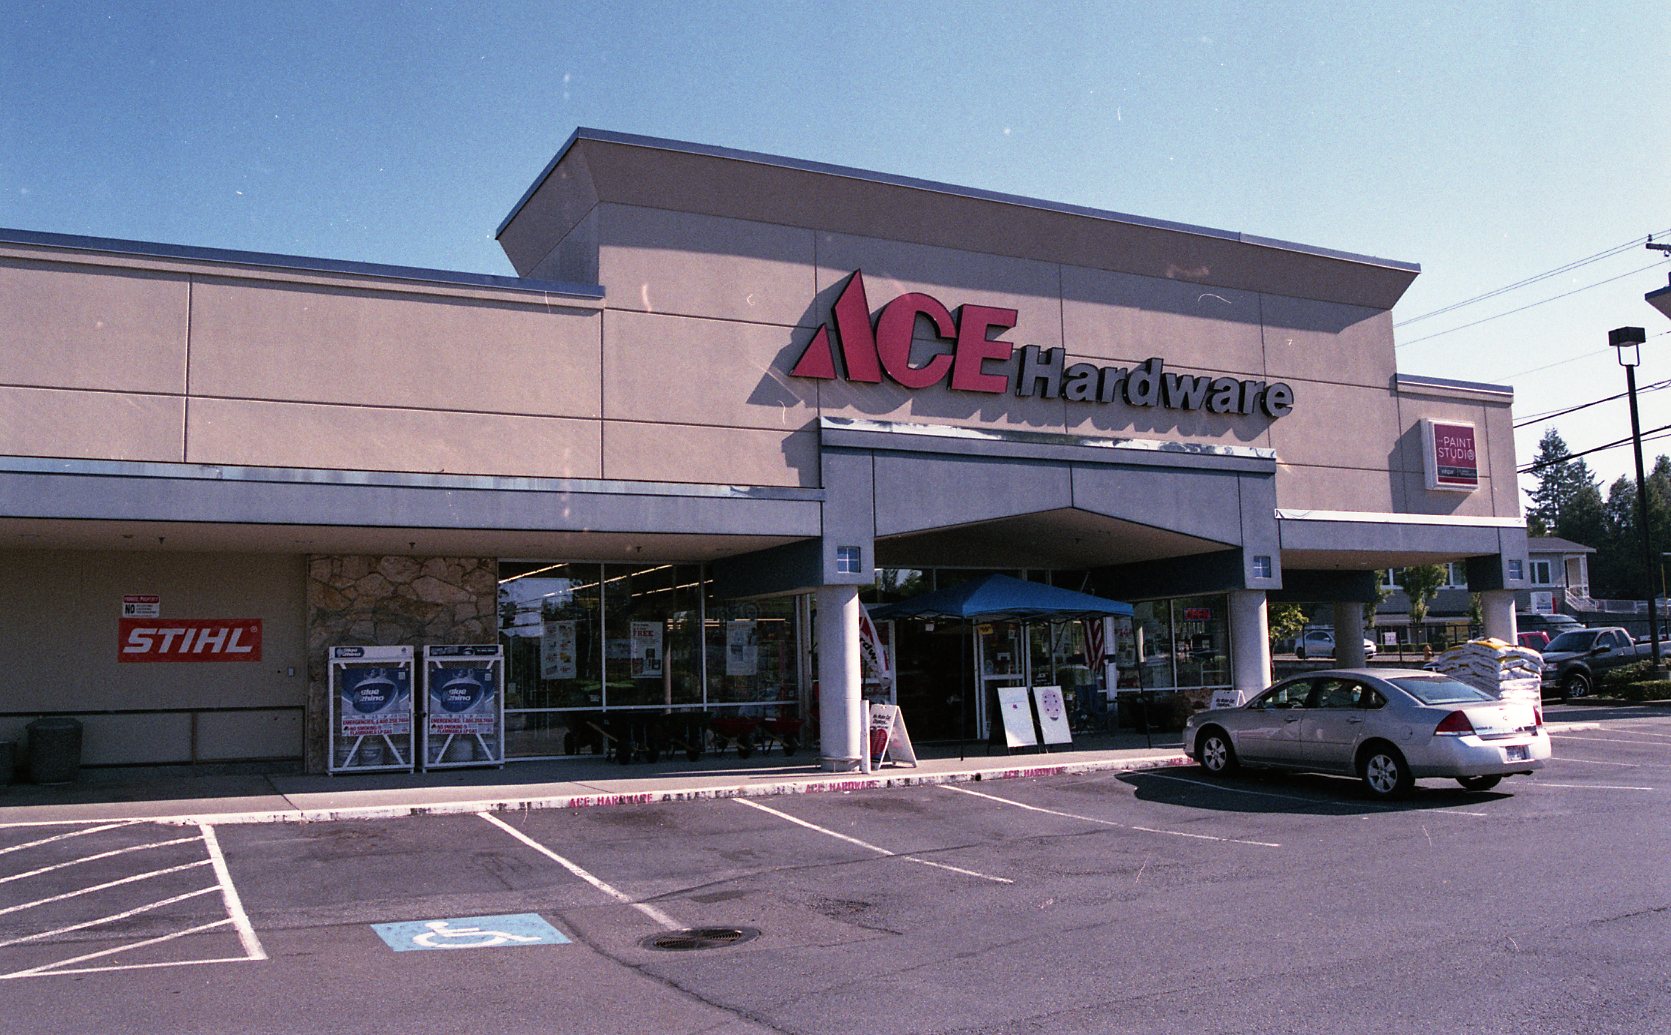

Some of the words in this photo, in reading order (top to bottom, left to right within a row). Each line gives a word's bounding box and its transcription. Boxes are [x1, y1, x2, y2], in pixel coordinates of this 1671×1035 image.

[790, 268, 1018, 393] ACE
[1016, 344, 1294, 419] Hardware
[1443, 436, 1472, 449] PAINT
[1438, 447, 1474, 461] STUDIO
[125, 604, 135, 614] NO
[122, 628, 253, 653] STIHL
[1003, 769, 1019, 779] ACE
[806, 784, 825, 794] ACE
[828, 780, 880, 793] HARDWARE
[570, 797, 590, 808] ACE
[597, 793, 653, 806] HARDWARE
